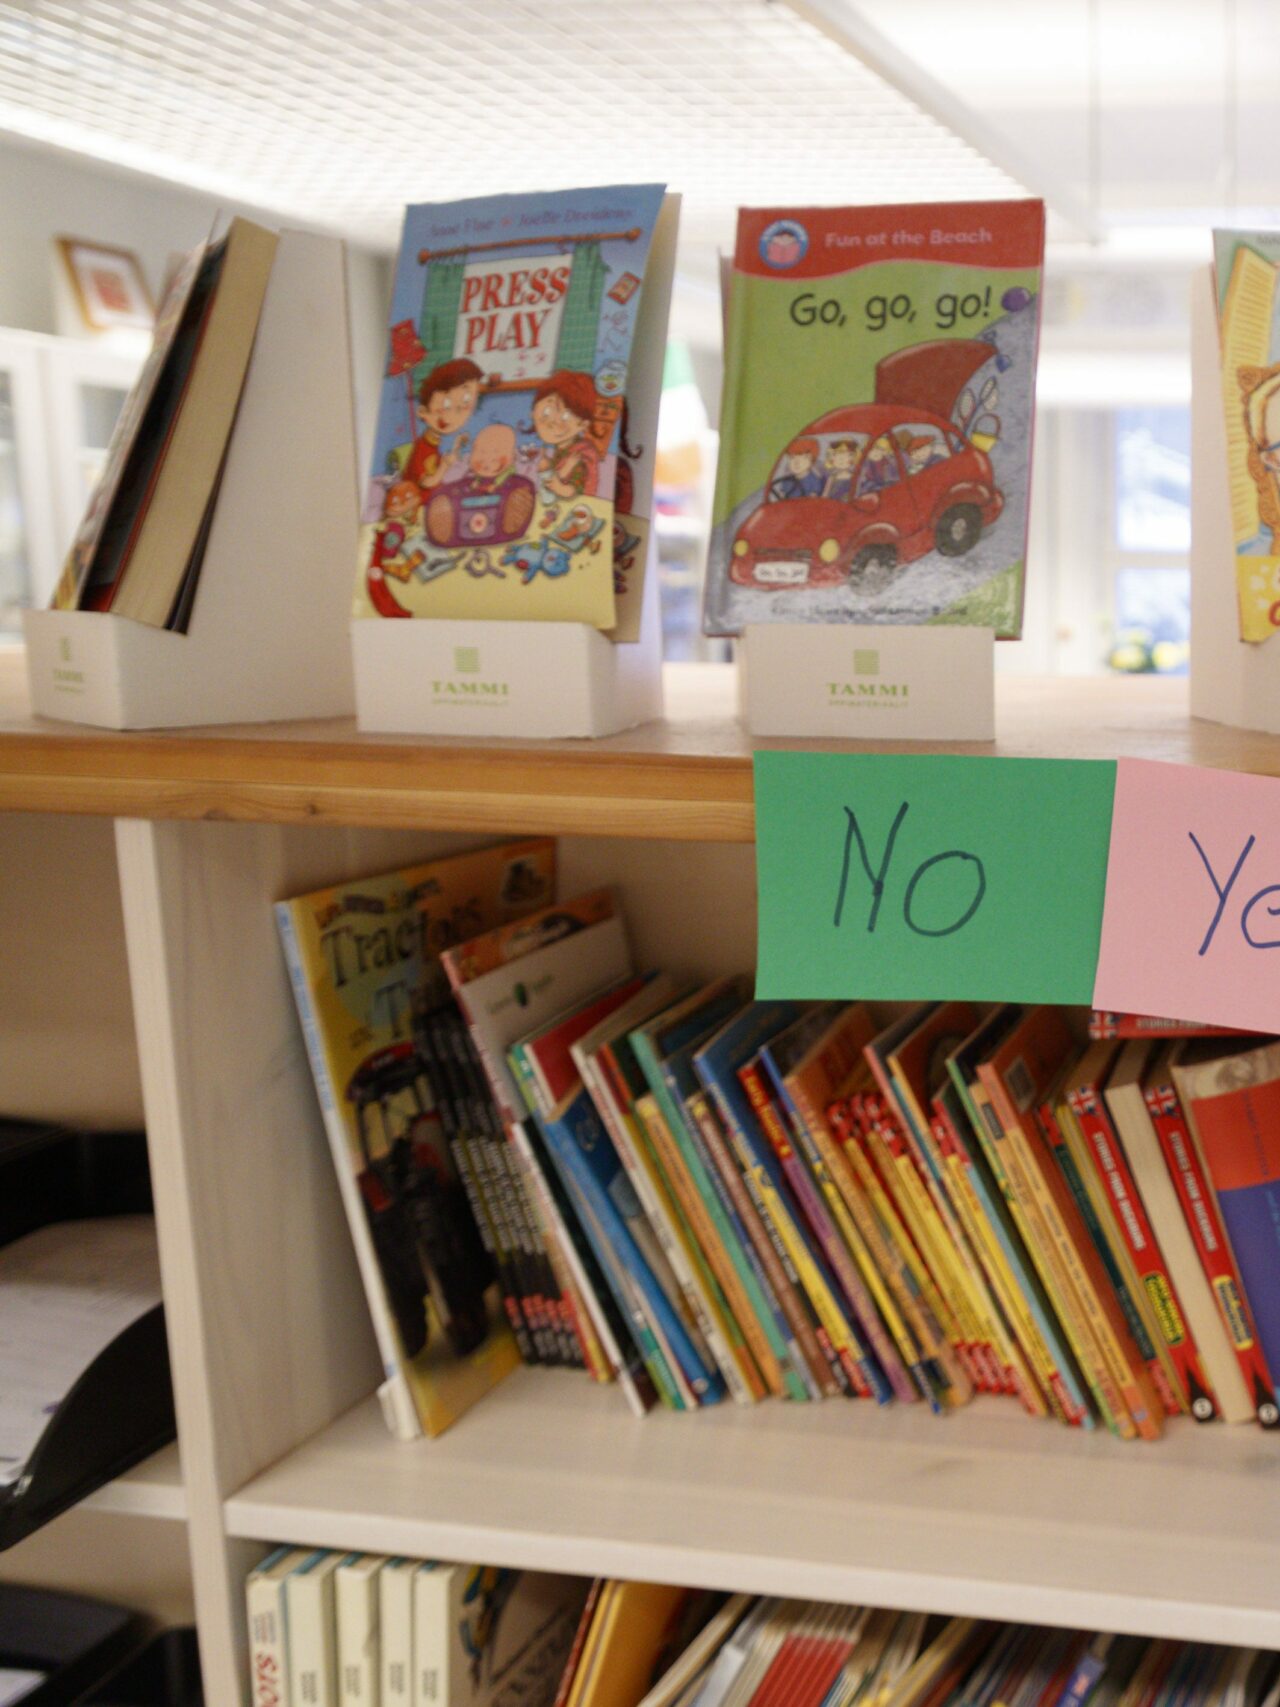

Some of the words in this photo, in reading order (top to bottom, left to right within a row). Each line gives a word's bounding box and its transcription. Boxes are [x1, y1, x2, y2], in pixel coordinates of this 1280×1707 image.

[824, 233, 861, 248] Fun
[866, 233, 887, 247] at
[891, 230, 924, 246] the
[929, 228, 992, 246] Beach
[460, 266, 572, 314] PRESS
[790, 292, 848, 328] Go,
[865, 293, 917, 332] go,
[934, 285, 992, 329] go!
[465, 308, 553, 355] PLAY
[826, 682, 909, 696] TAMMI
[832, 801, 987, 938] No
